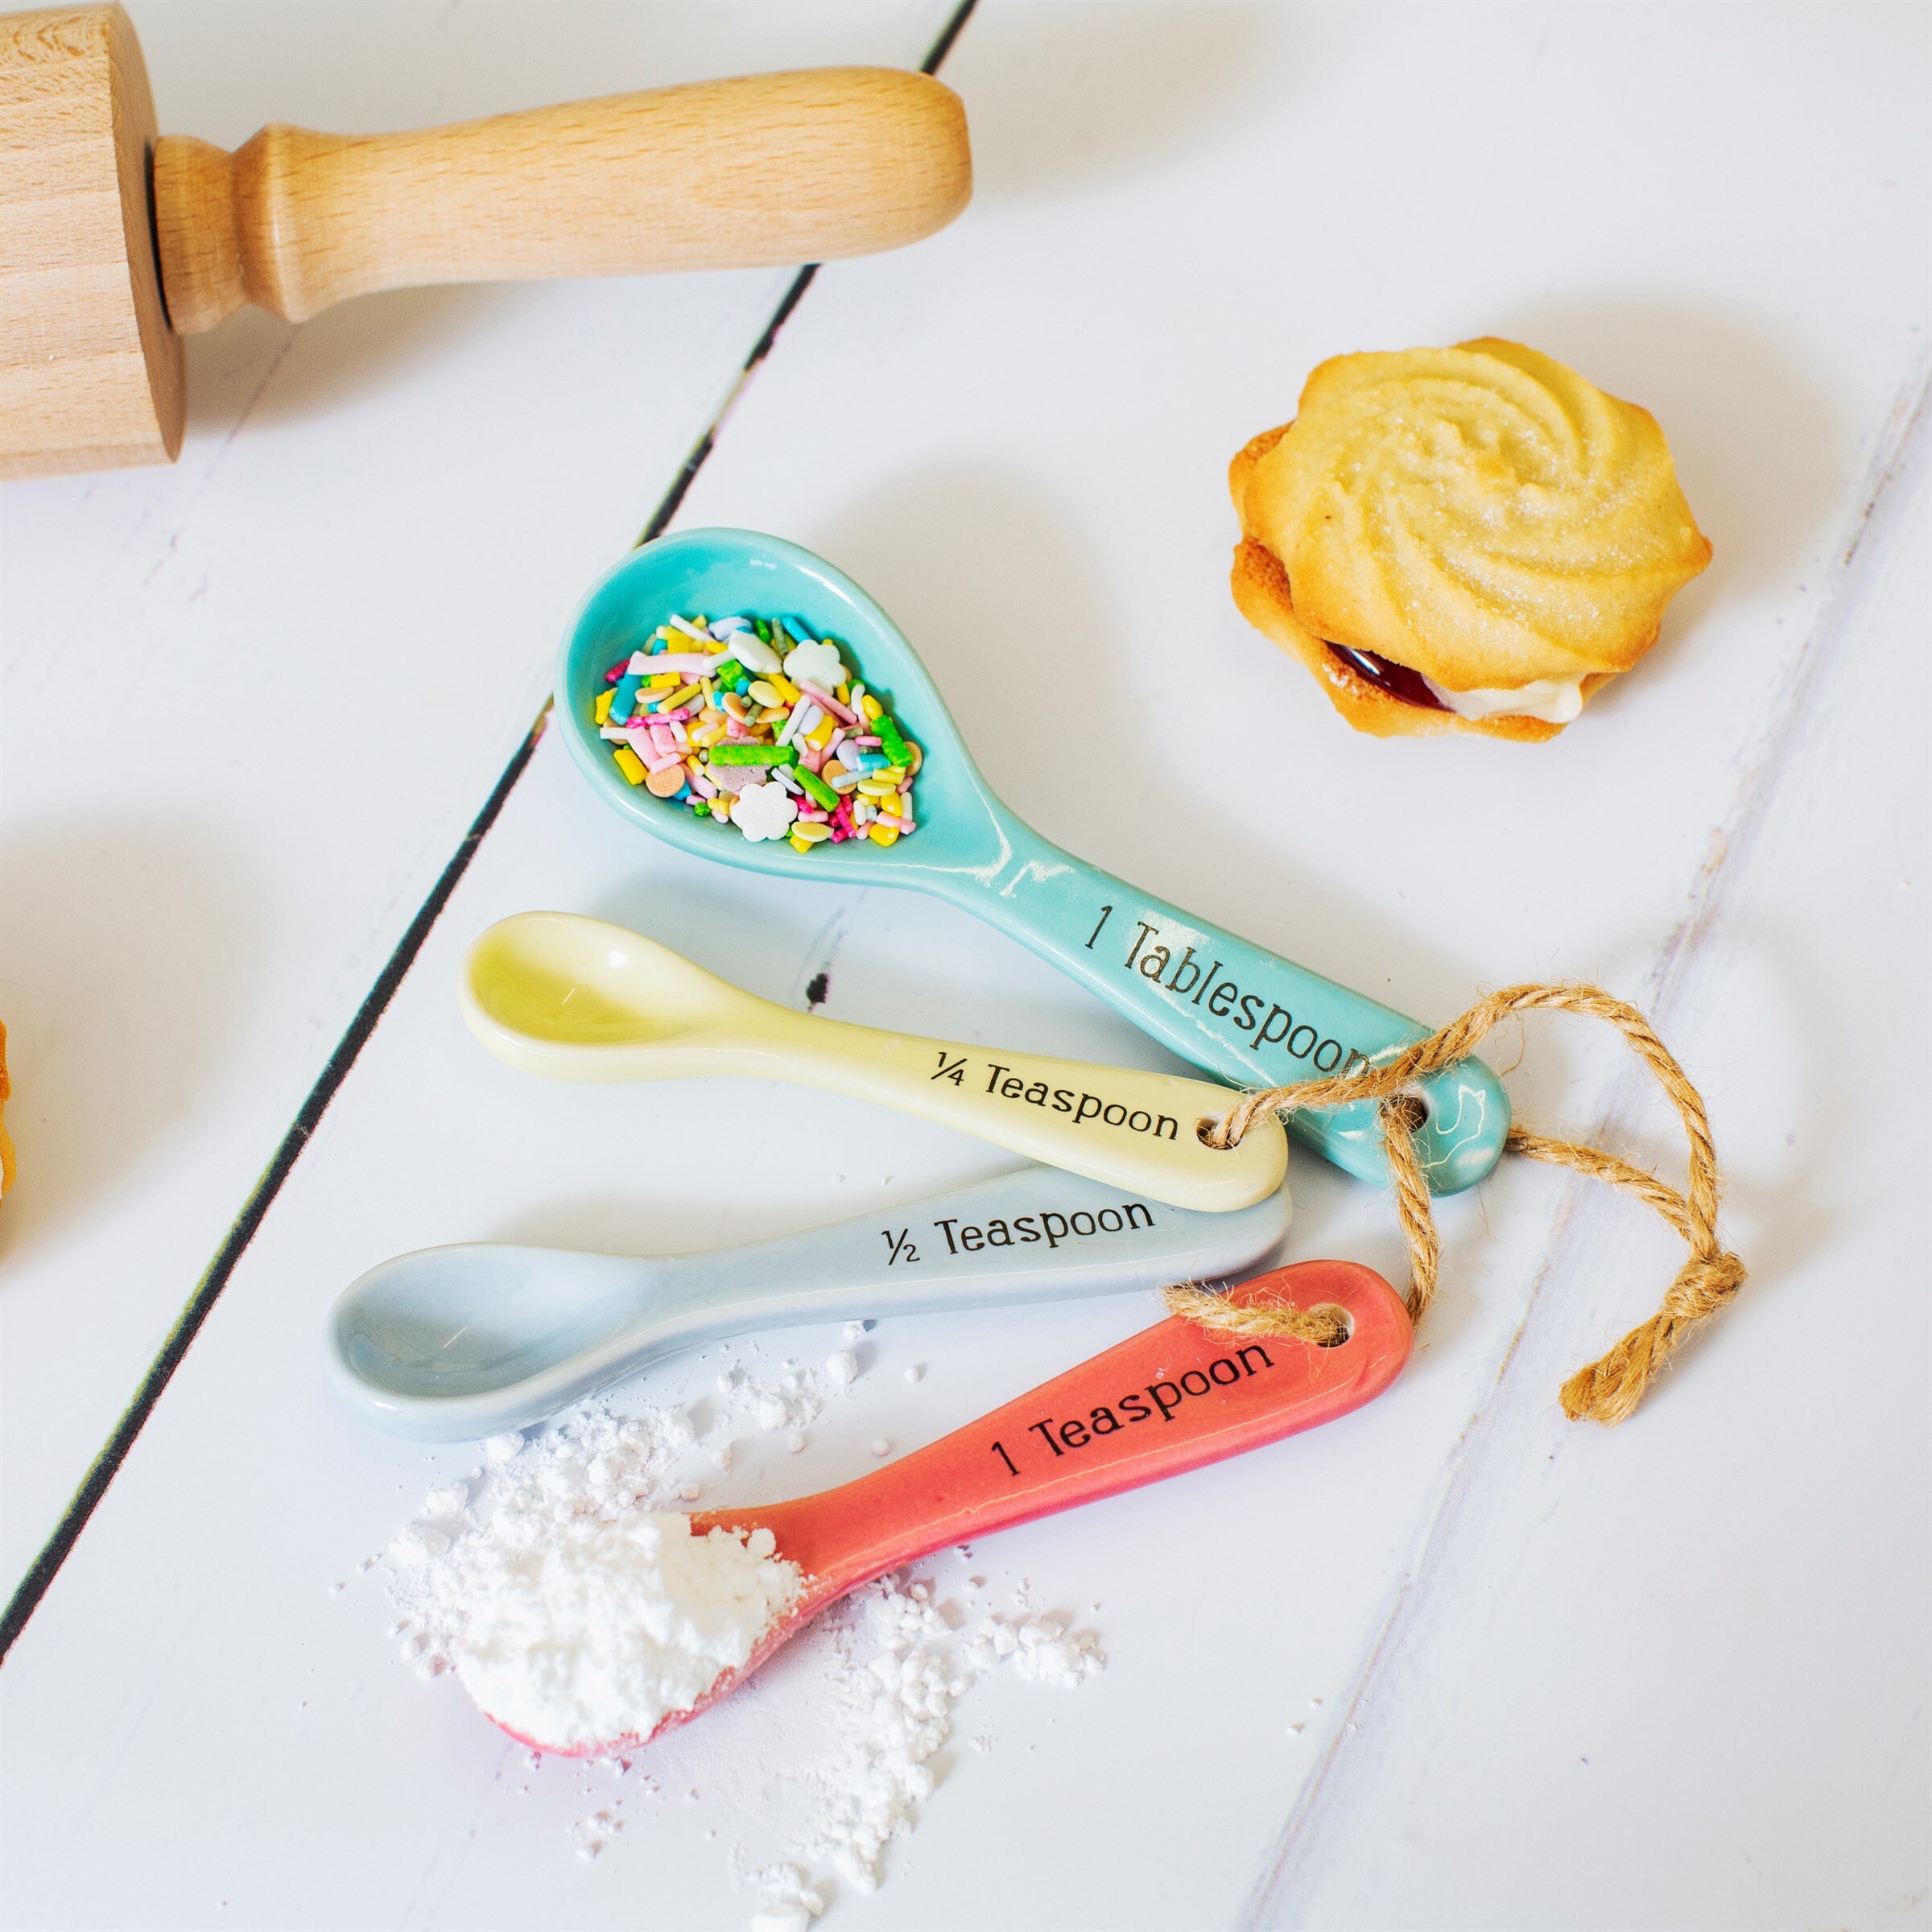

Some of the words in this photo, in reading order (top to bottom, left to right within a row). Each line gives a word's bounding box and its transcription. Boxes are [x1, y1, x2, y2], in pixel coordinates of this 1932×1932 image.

[1084, 905, 1113, 950] 1
[1124, 921, 1370, 1077] Tablespoon
[985, 1063, 1179, 1141] Teaspoon
[933, 1203, 1156, 1255] Teaspoon
[991, 1441, 1021, 1477] 1
[1028, 1344, 1275, 1457] Teaspoon
